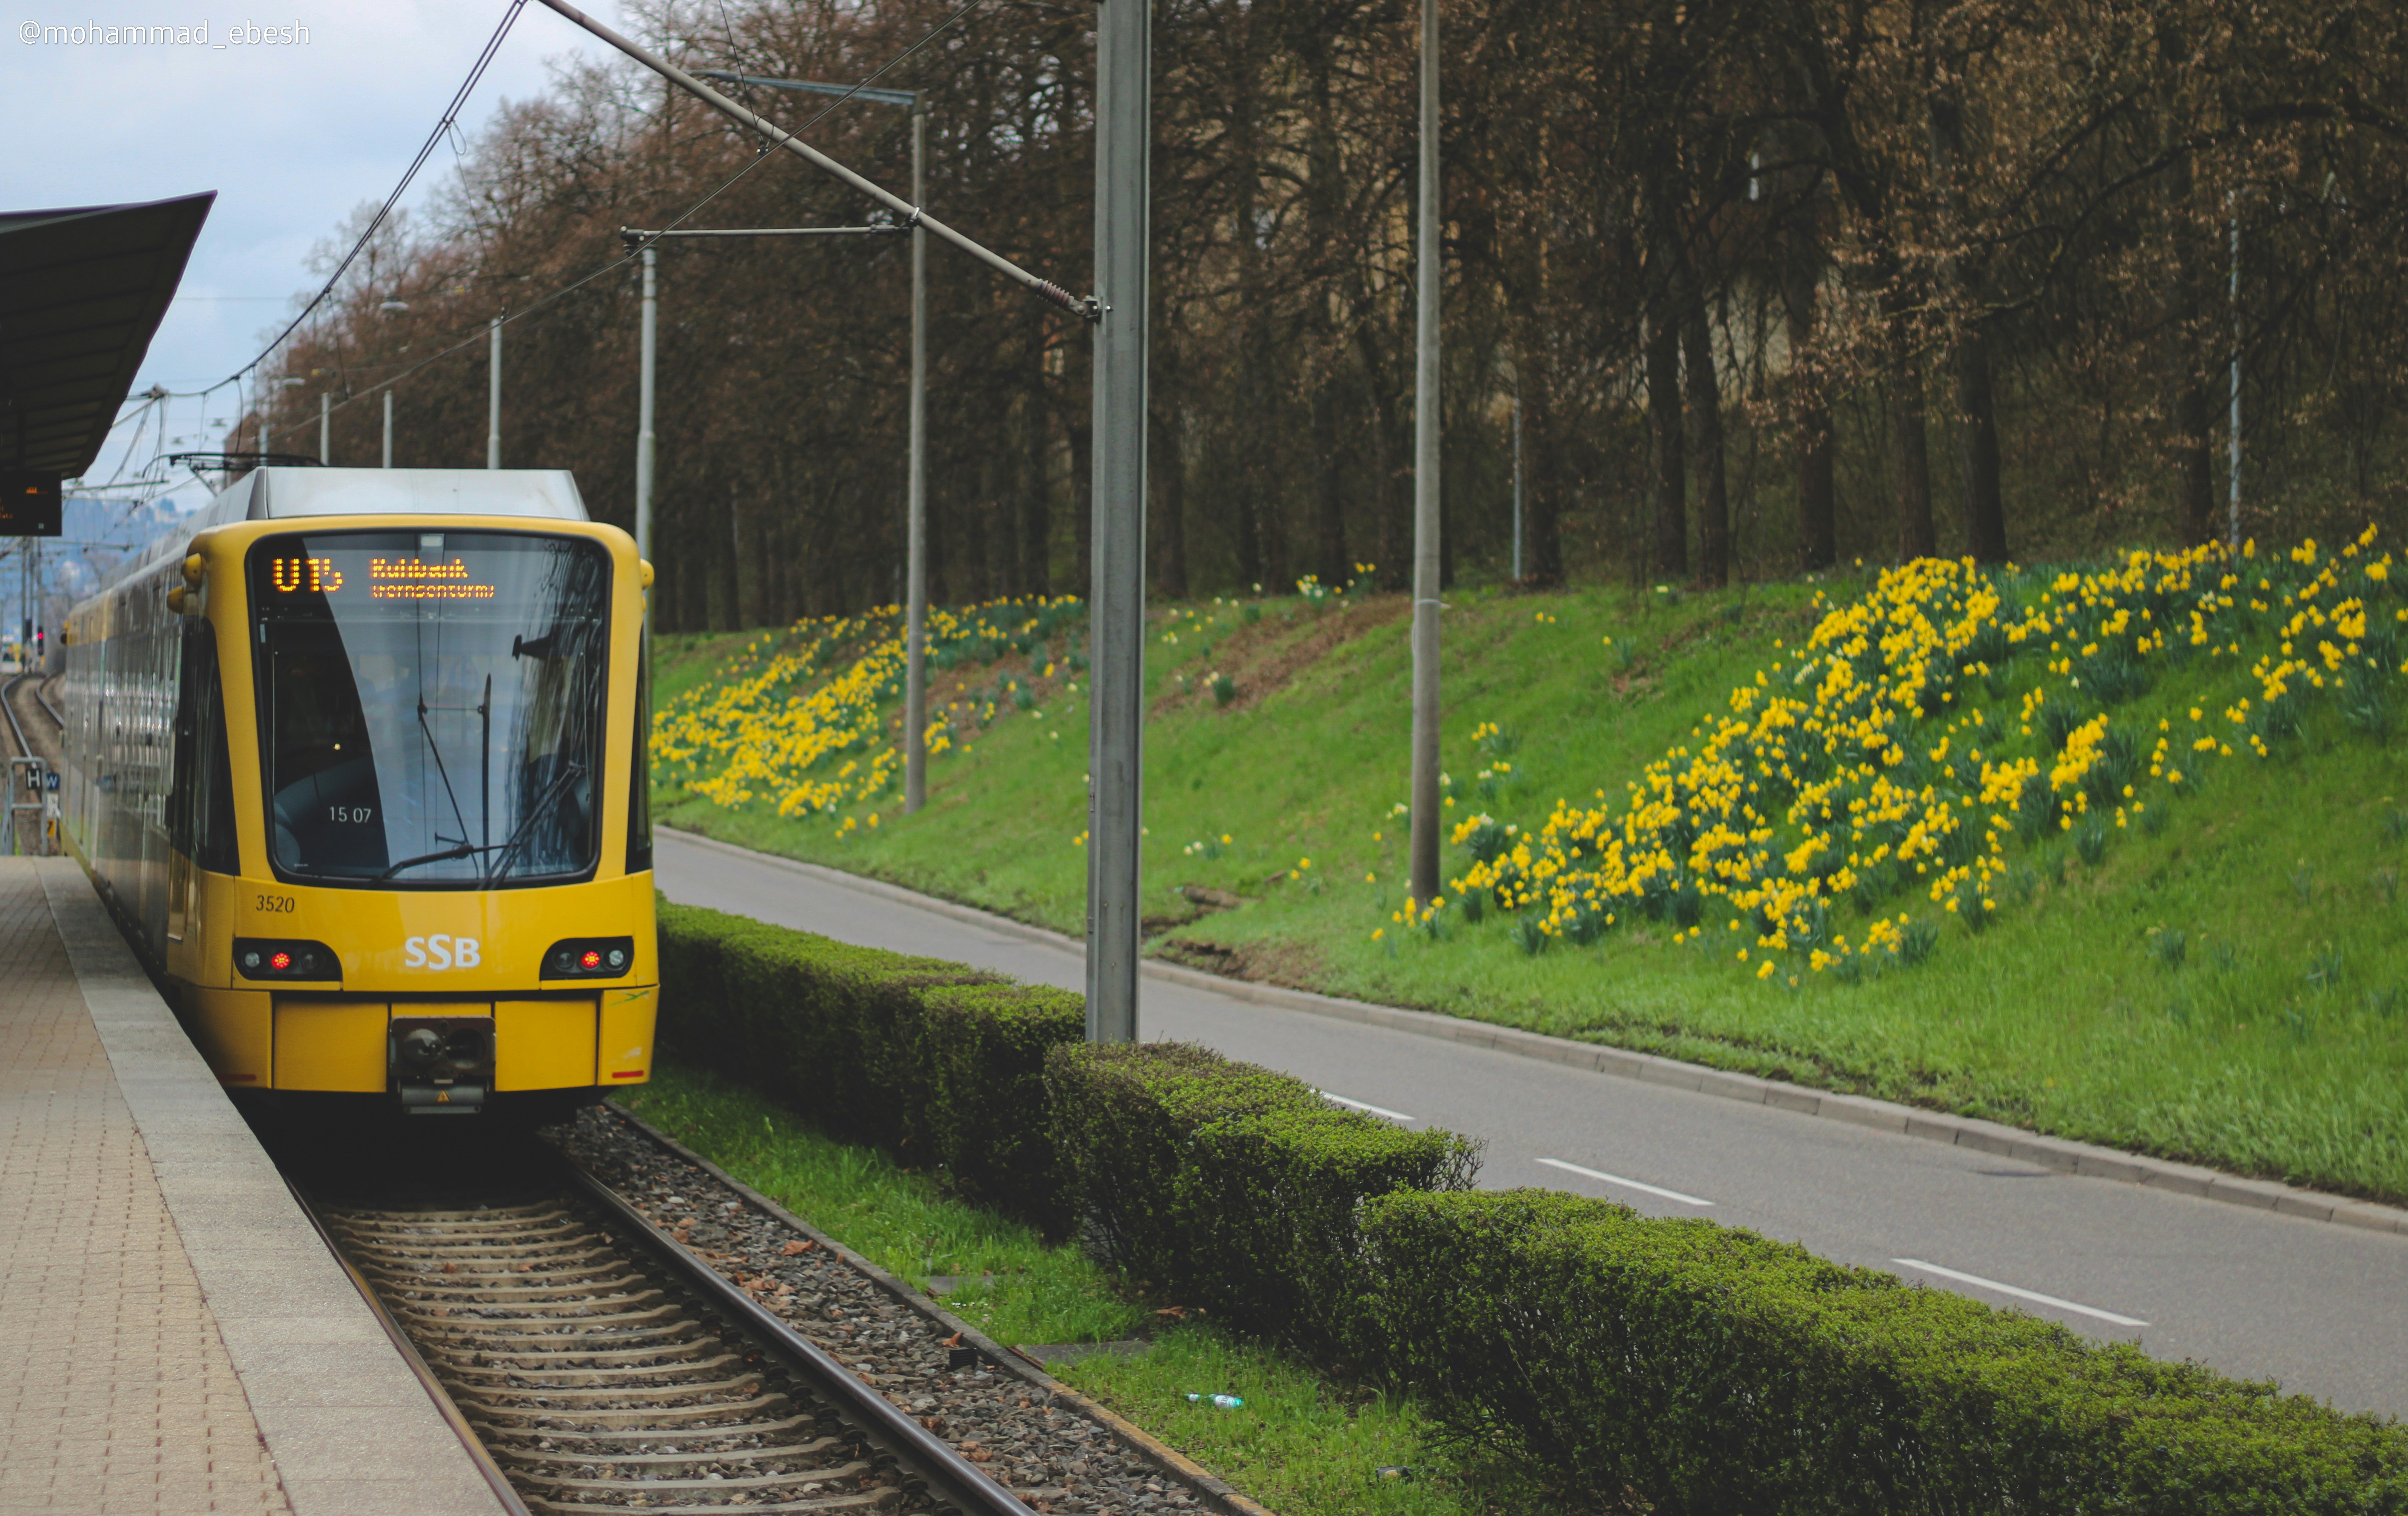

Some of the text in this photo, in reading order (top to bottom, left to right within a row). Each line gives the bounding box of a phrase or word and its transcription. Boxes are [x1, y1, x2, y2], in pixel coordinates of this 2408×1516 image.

[27, 770, 40, 788] H
[329, 806, 371, 823] 15 07
[256, 894, 295, 913] 3520
[405, 933, 481, 971] SSB
